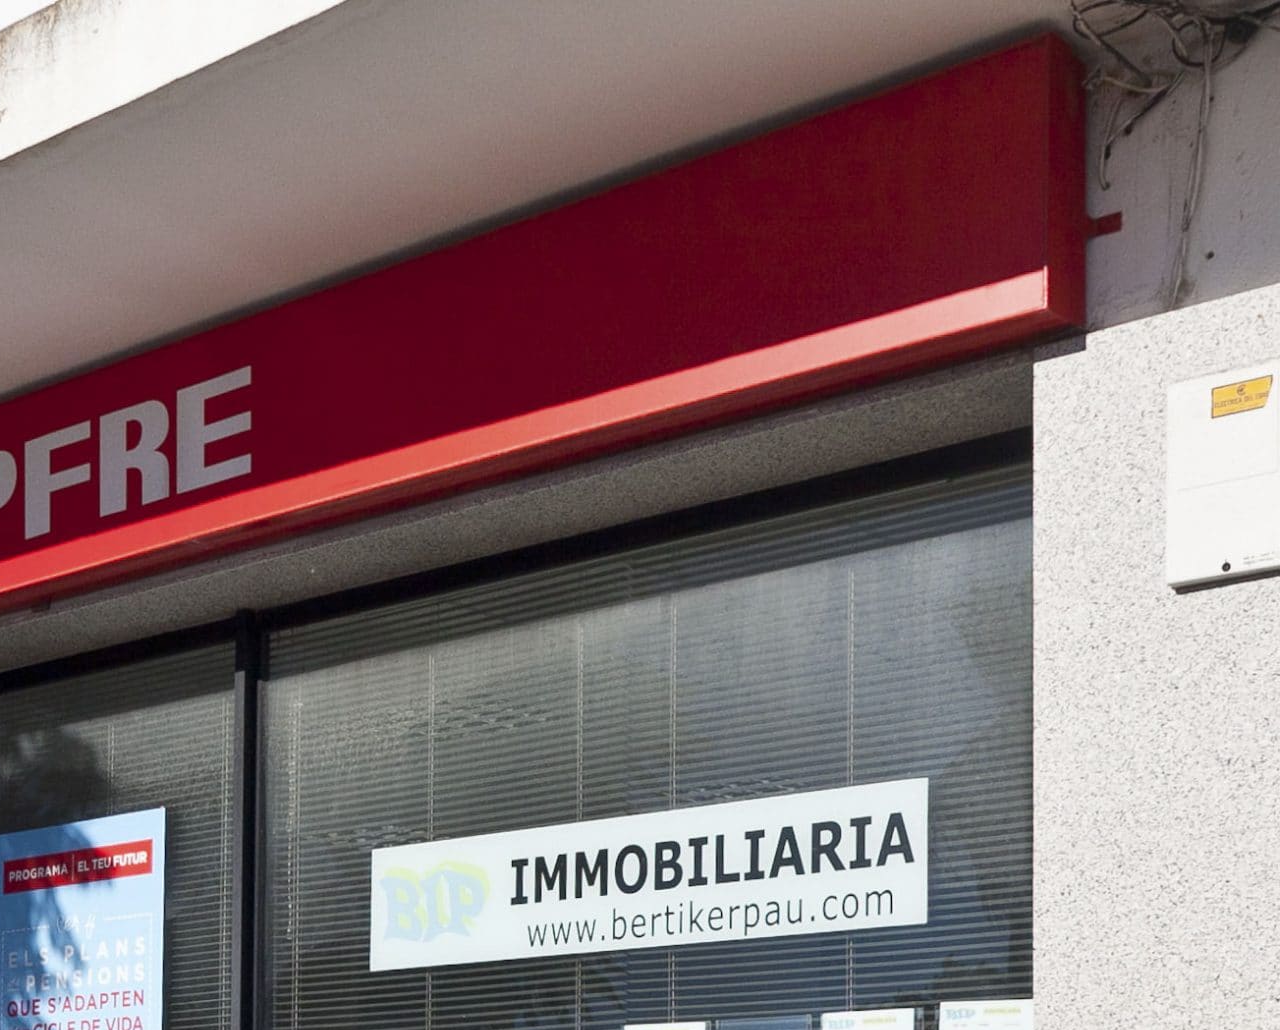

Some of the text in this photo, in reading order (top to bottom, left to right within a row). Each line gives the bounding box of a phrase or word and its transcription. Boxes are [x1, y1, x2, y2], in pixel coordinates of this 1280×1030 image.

[9, 851, 148, 883] PROGRAMA EL TEU FUTUR
[509, 811, 915, 906] IMMOBILIARIA
[379, 860, 491, 943] BIP
[526, 889, 895, 947] www.bertikerpau.com
[8, 936, 145, 969] ELS PLANS
[26, 962, 145, 993] PENSIONS
[7, 989, 144, 1017] QUE S'ADAPTEN
